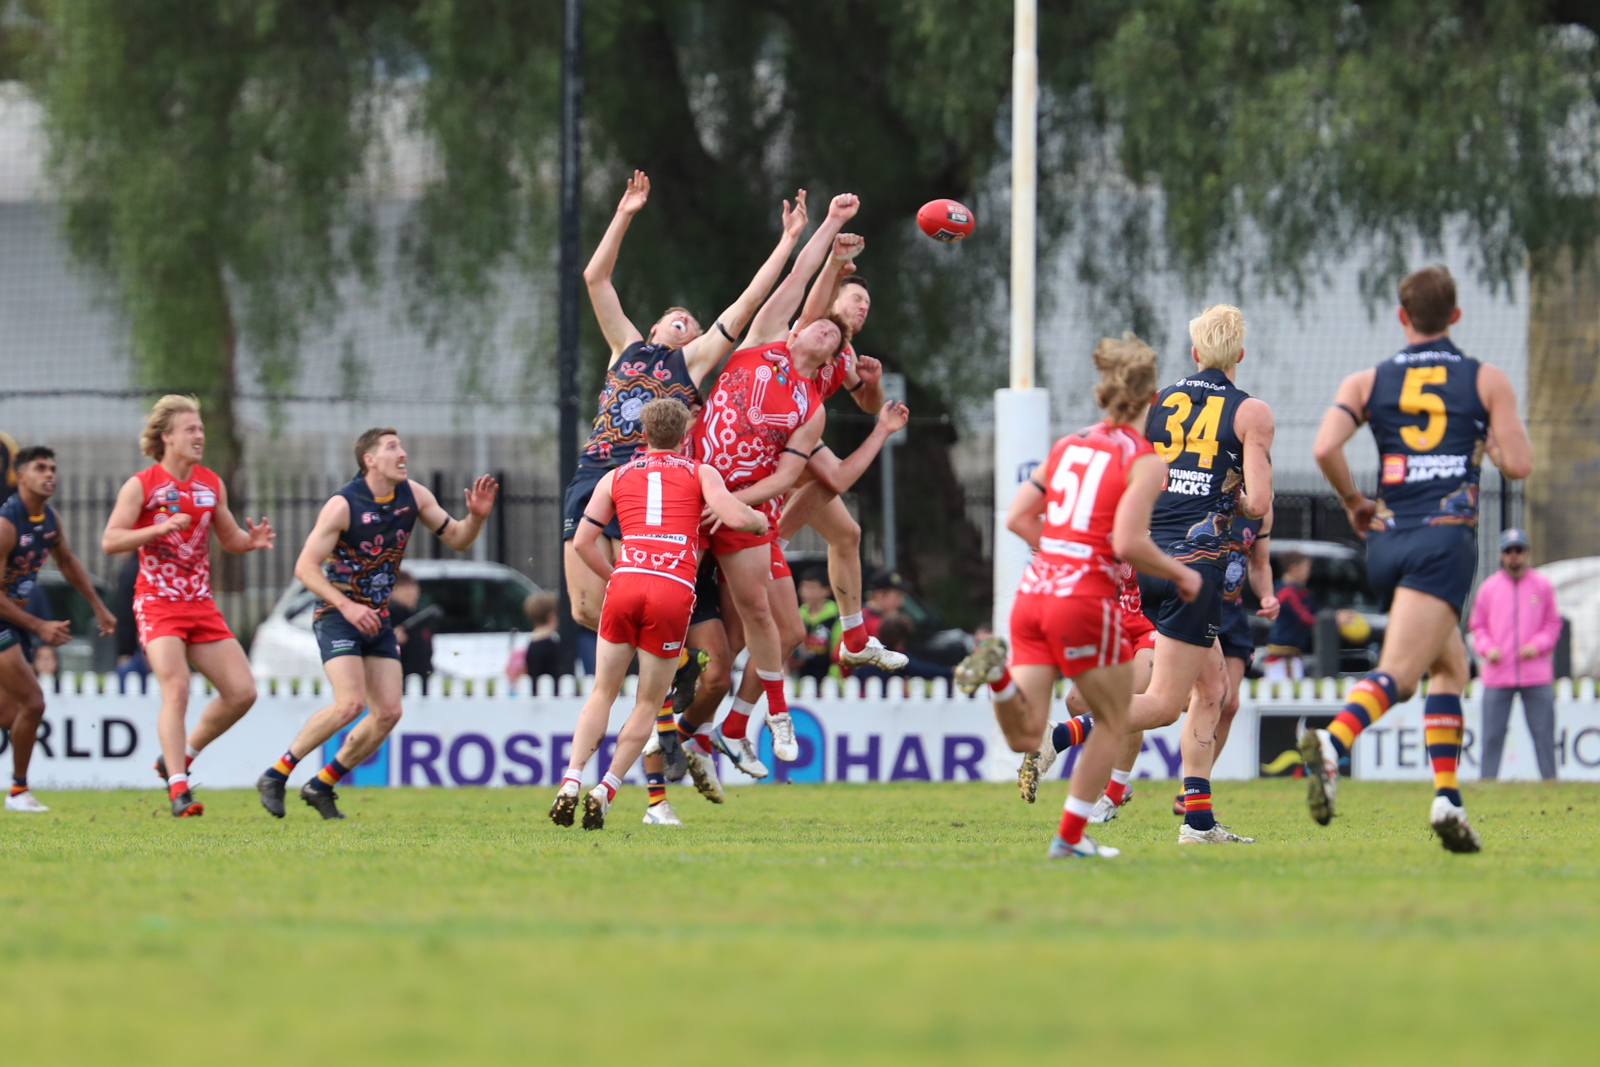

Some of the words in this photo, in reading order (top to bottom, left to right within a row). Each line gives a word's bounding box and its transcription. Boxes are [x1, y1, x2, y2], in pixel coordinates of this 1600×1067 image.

[952, 213, 967, 222] END
[1399, 366, 1447, 451] 5
[1153, 391, 1226, 469] 34
[1169, 468, 1213, 483] HUNGRY
[1406, 454, 1468, 467] HUNGRY
[646, 472, 662, 526] 1
[1047, 444, 1112, 533] 51
[1167, 479, 1211, 496] JACK'S
